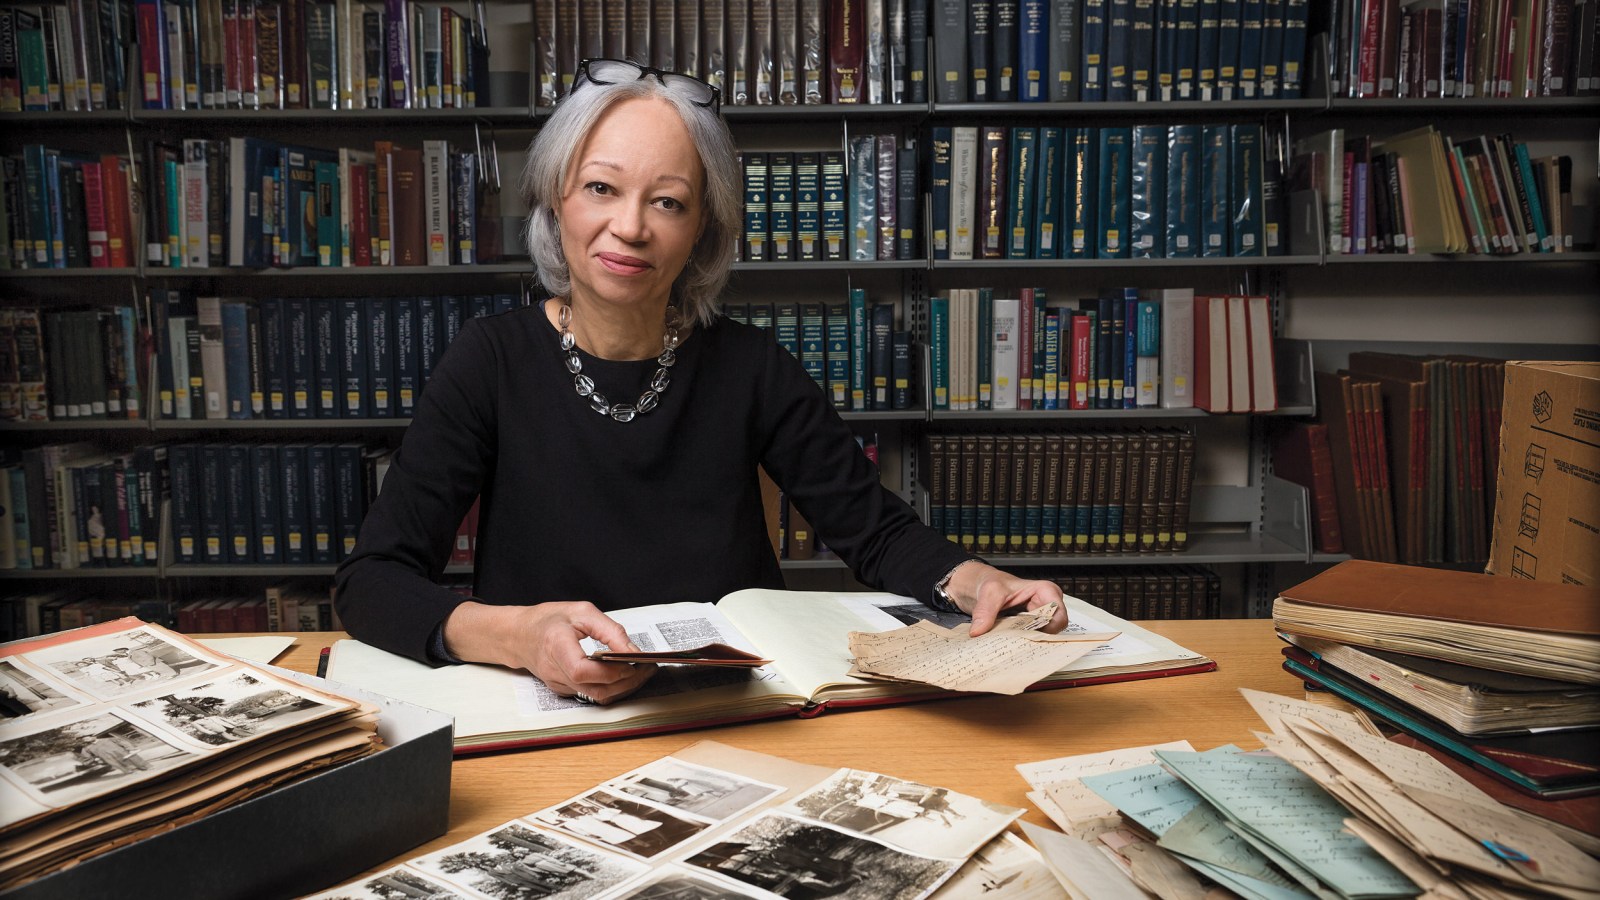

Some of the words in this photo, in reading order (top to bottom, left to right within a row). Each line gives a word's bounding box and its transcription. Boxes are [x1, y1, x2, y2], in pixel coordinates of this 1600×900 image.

[2, 15, 13, 63] OXFORD
[836, 67, 851, 75] Volume
[431, 176, 440, 198] WOMEN
[432, 206, 441, 232] AMERICA
[855, 348, 863, 370] American
[1046, 330, 1058, 353] SISTER
[1046, 354, 1057, 372] DAYS
[933, 458, 942, 501] Britannica
[949, 458, 958, 501] Britannica
[966, 458, 974, 501] Britannica
[982, 458, 992, 501] Britannica
[998, 458, 1008, 501] Britannica
[1015, 458, 1025, 501] Britannica
[1031, 458, 1041, 501] Britannica
[1048, 457, 1059, 501] Britannica
[1066, 458, 1076, 501] Britannica
[1082, 458, 1093, 501] Britannica
[1098, 458, 1108, 500] Britannica
[1113, 457, 1123, 500] Britannica
[1130, 457, 1140, 499] Britannica
[1147, 457, 1158, 499] Britannica
[1164, 456, 1174, 499] Britannica
[1181, 455, 1192, 498] Britannica
